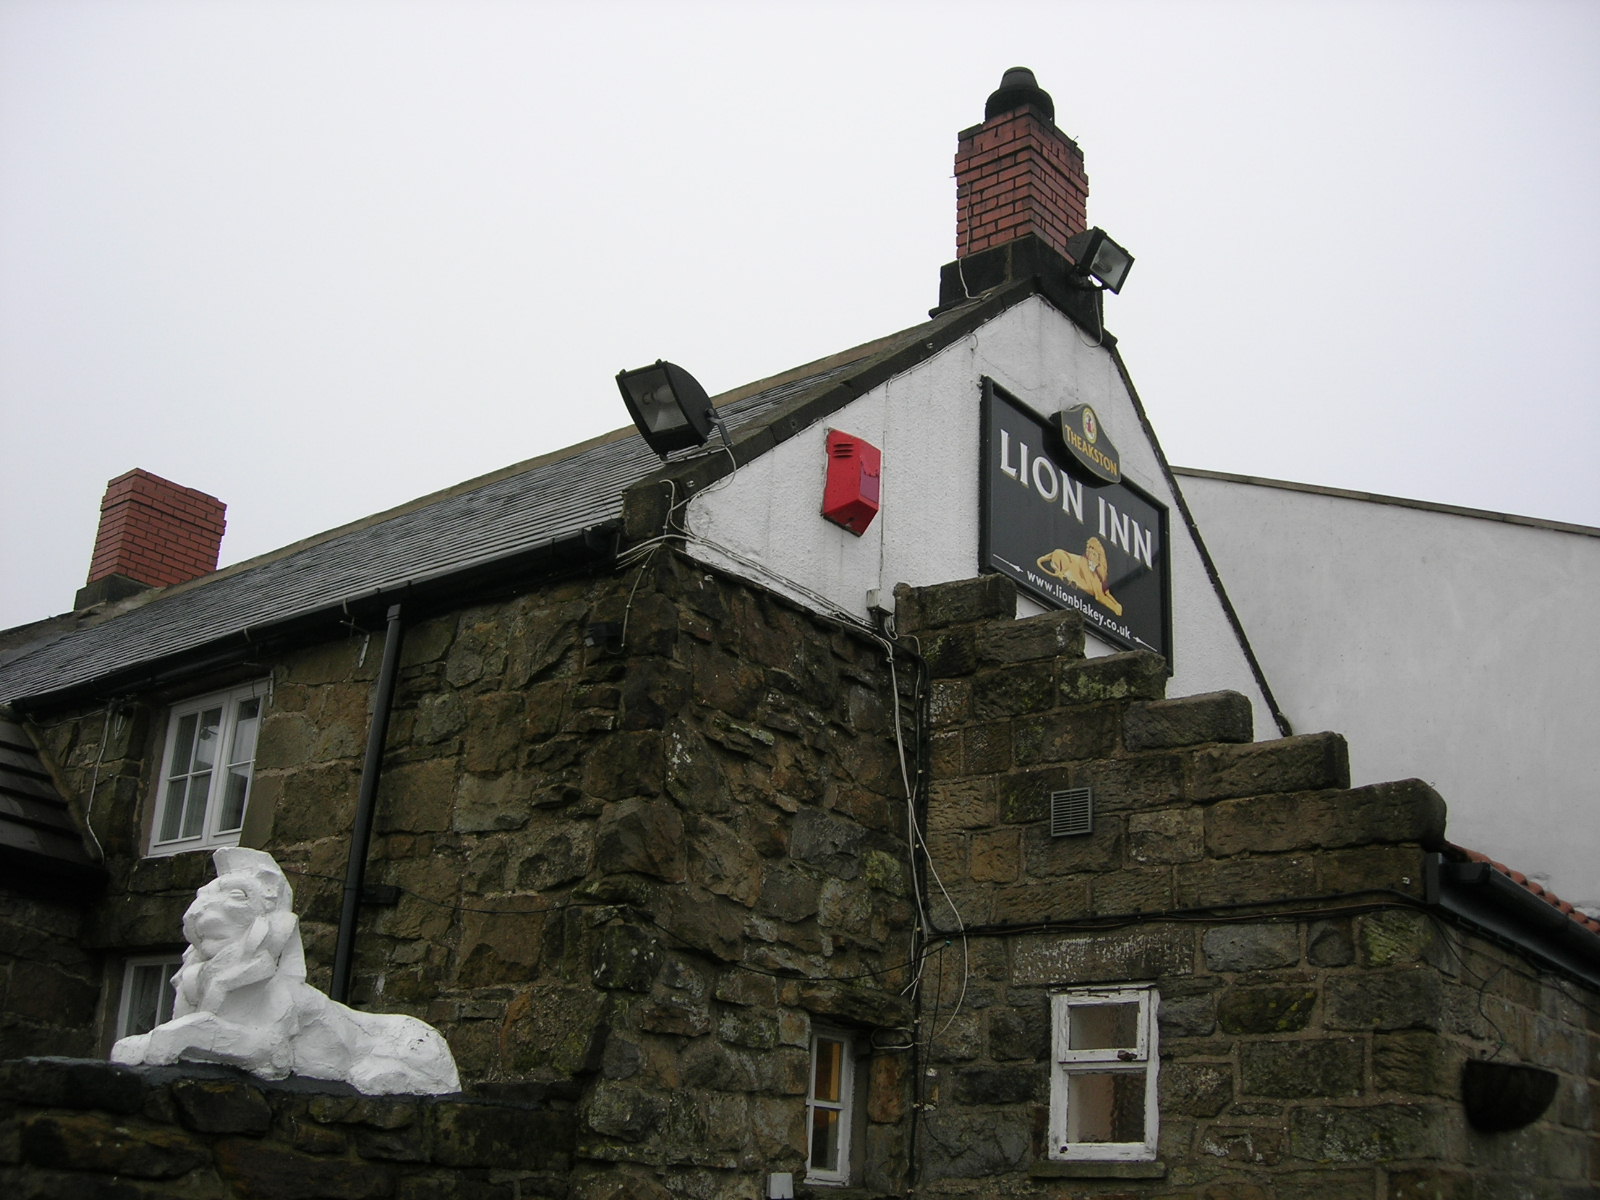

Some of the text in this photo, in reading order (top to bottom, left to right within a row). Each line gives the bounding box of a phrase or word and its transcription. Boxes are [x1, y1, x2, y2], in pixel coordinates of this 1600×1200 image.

[1064, 423, 1118, 477] THEAKSTON
[1000, 428, 1153, 571] LION INN
[1026, 570, 1132, 640] www.lionblakey.co.uk
